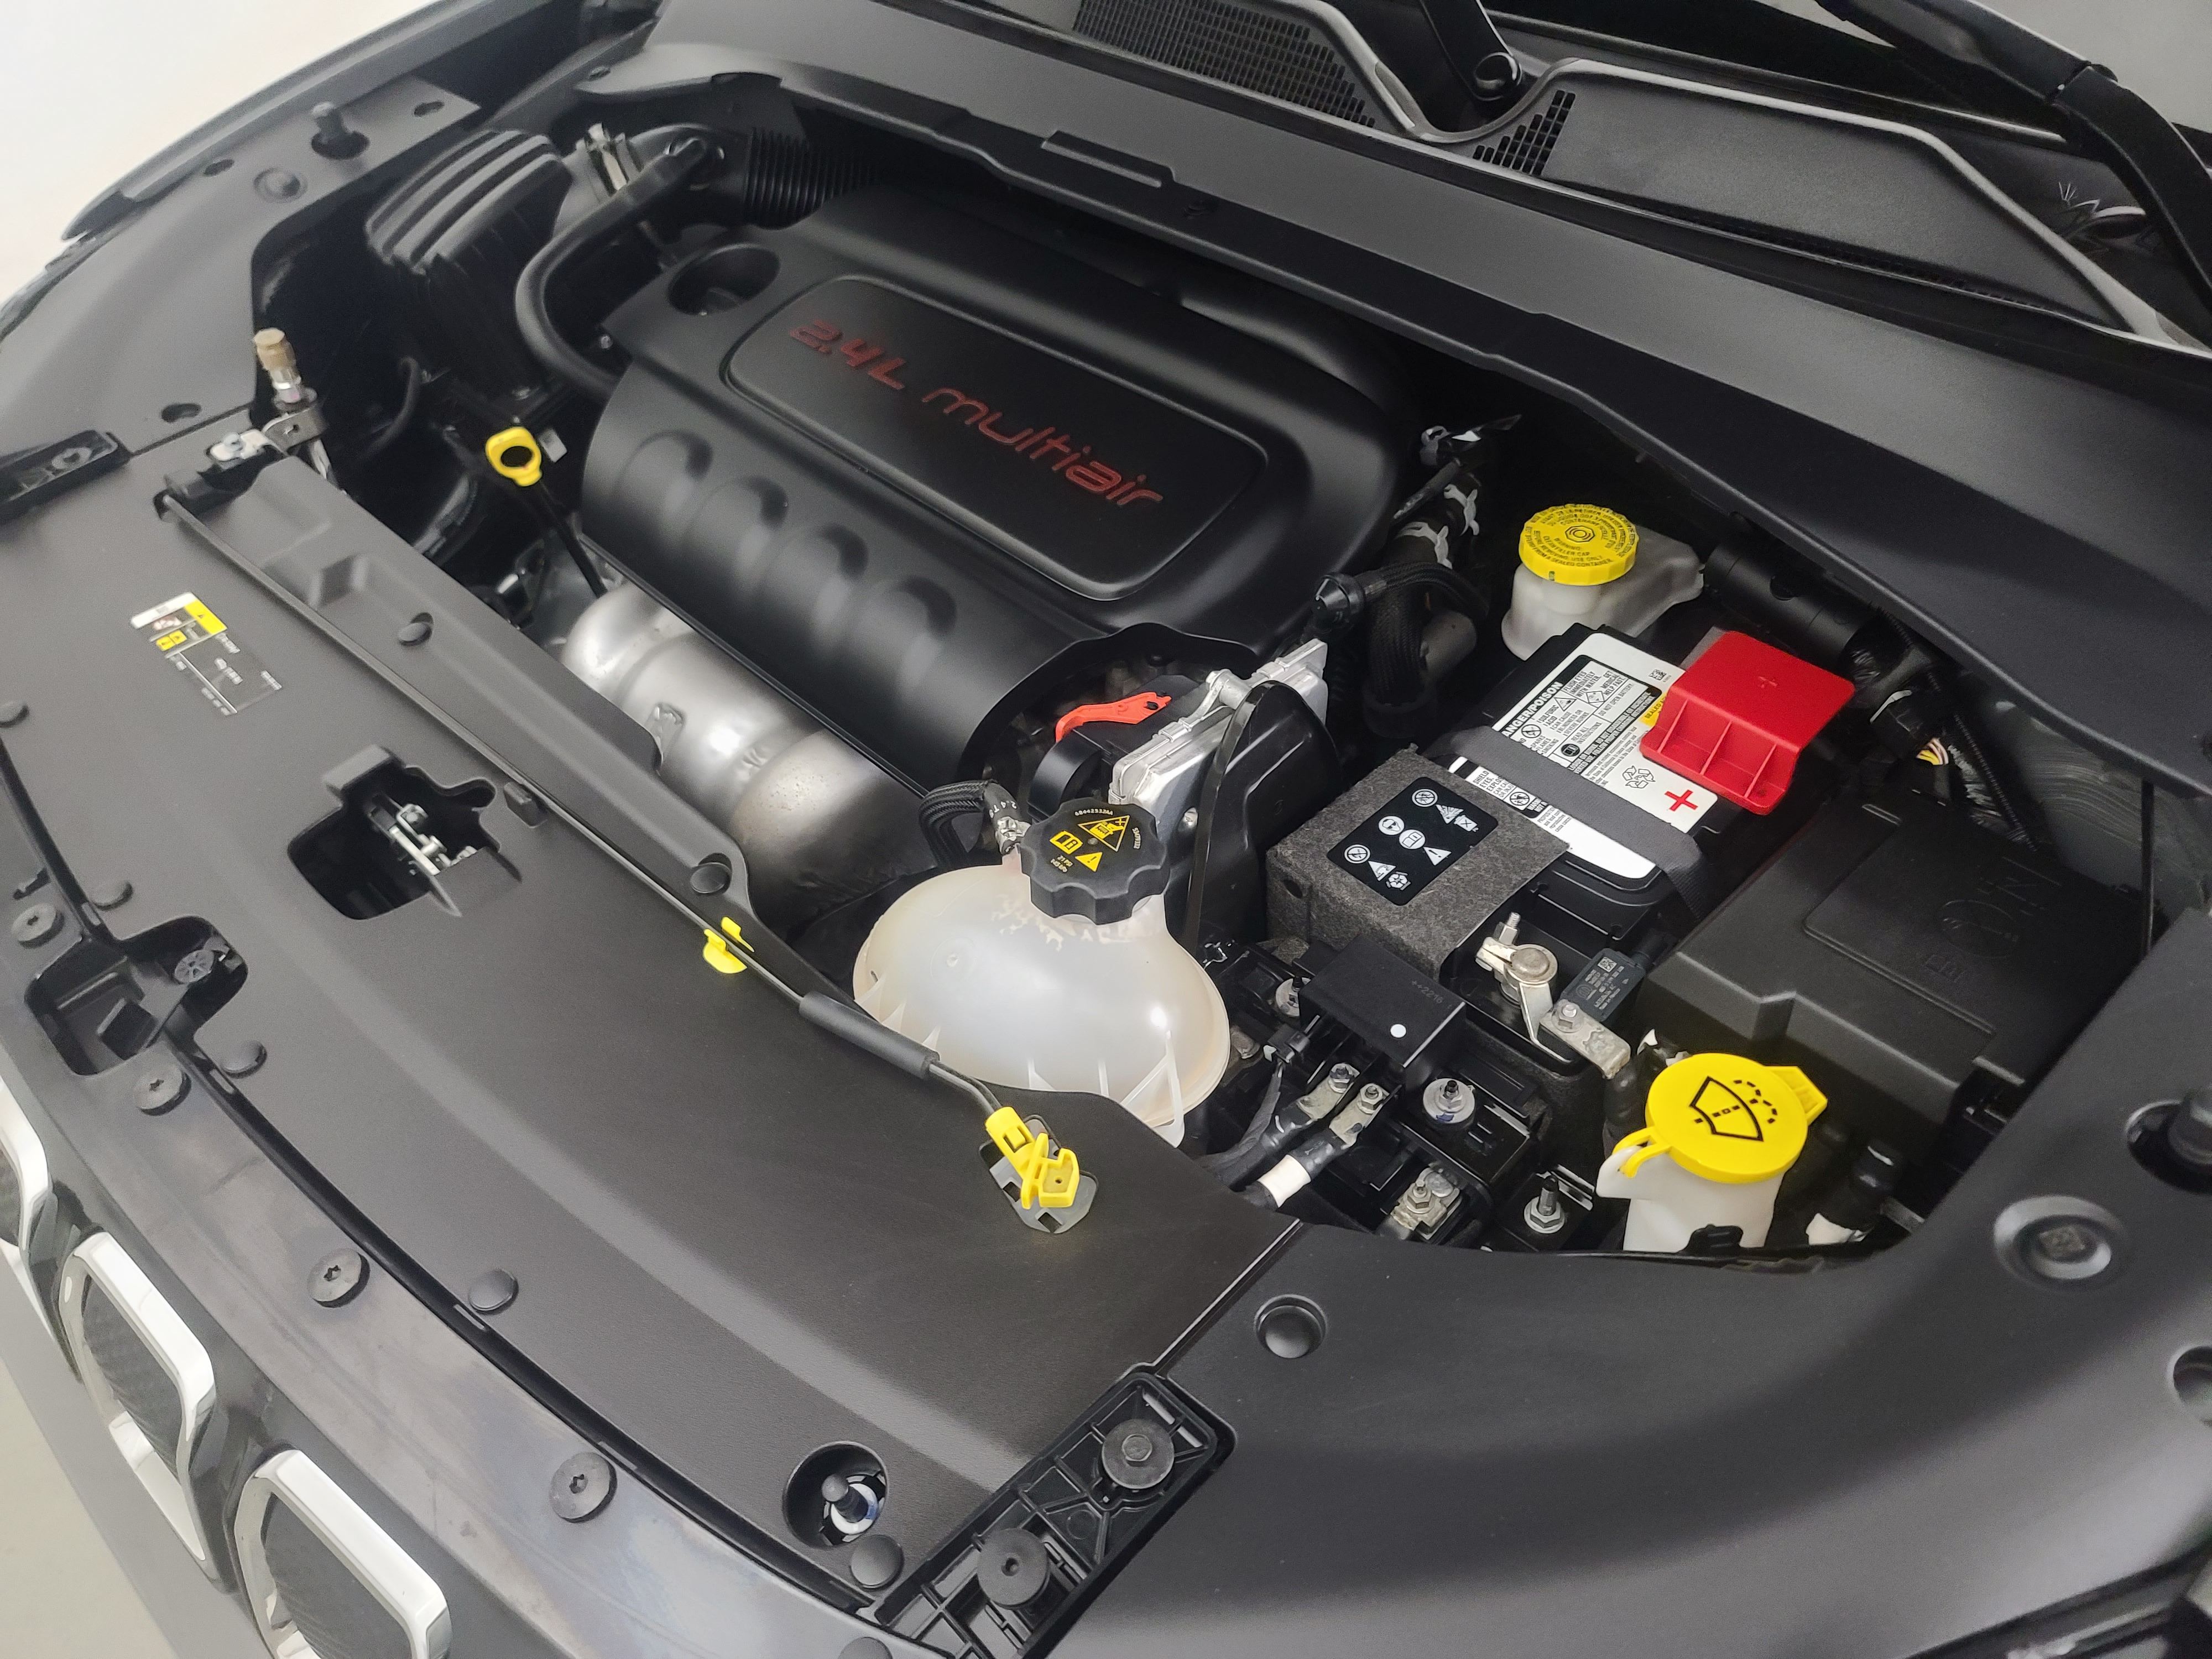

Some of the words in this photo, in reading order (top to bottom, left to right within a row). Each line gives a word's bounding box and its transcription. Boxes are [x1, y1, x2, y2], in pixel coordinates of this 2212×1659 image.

[790, 319, 905, 390] 2.4L
[921, 387, 1164, 506] multiair
[1577, 559, 1613, 567] CONTAINER
[1563, 680, 1577, 691] FLUSH
[1574, 671, 1586, 681] EYES
[1569, 671, 1595, 694] IMMEDIATELY
[1600, 673, 1619, 689] MEDICAL
[1575, 687, 1588, 697] WITH
[1603, 685, 1615, 695] HELP
[1610, 696, 1621, 705] OPEN
[1538, 705, 1558, 722] SULFURIC
[1558, 711, 1571, 722] CAUSE
[1645, 703, 1662, 718] SEALED
[1545, 716, 1557, 725] ACID
[1558, 714, 1578, 731] BLINDNESS
[1564, 722, 1579, 734] SEVERE
[1571, 732, 1582, 741] READ
[1473, 770, 1489, 784] SHIELD
